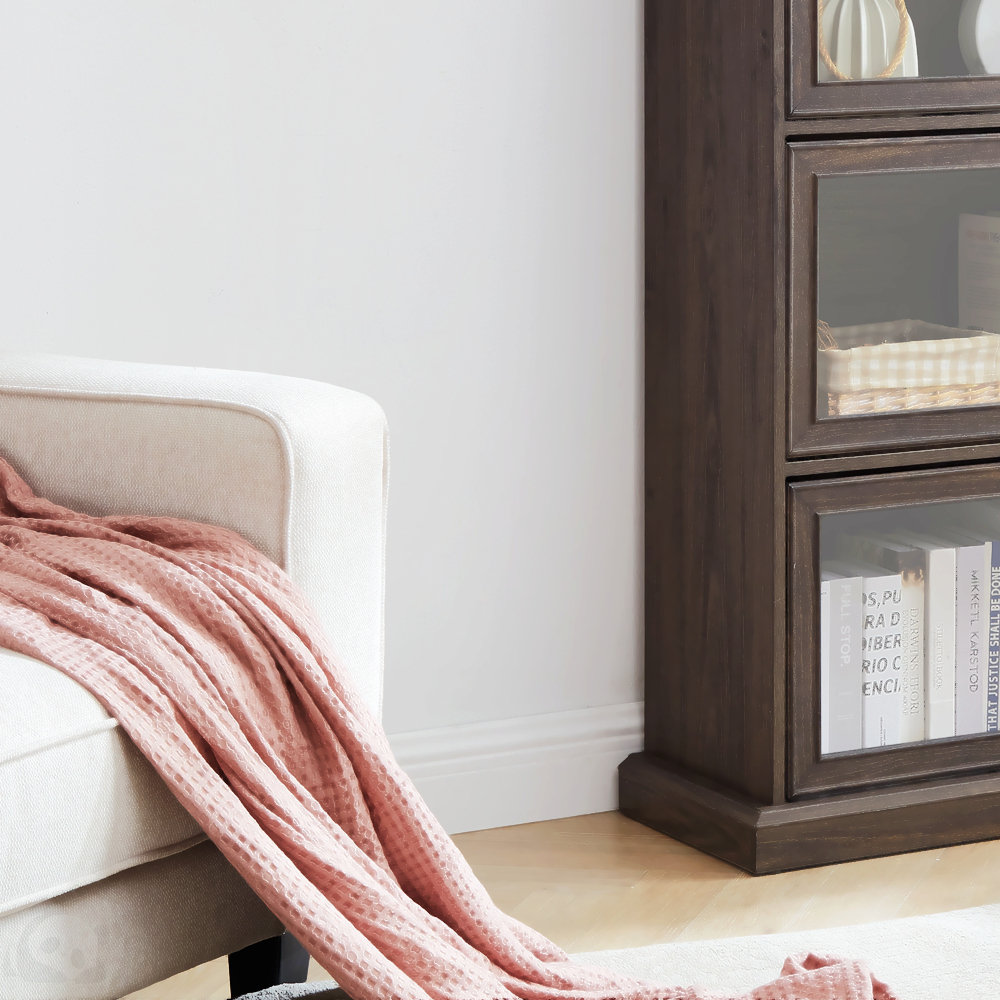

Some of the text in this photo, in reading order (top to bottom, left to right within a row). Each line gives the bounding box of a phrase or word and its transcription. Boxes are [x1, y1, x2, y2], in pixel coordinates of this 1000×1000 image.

[990, 598, 1000, 612] BE
[910, 608, 919, 671] DARWINS
[989, 613, 1000, 647] SHALL
[969, 631, 979, 693] KARSTOD
[988, 651, 999, 697] JUSTICE
[862, 678, 901, 696] ENCI
[987, 699, 997, 732] THAT
